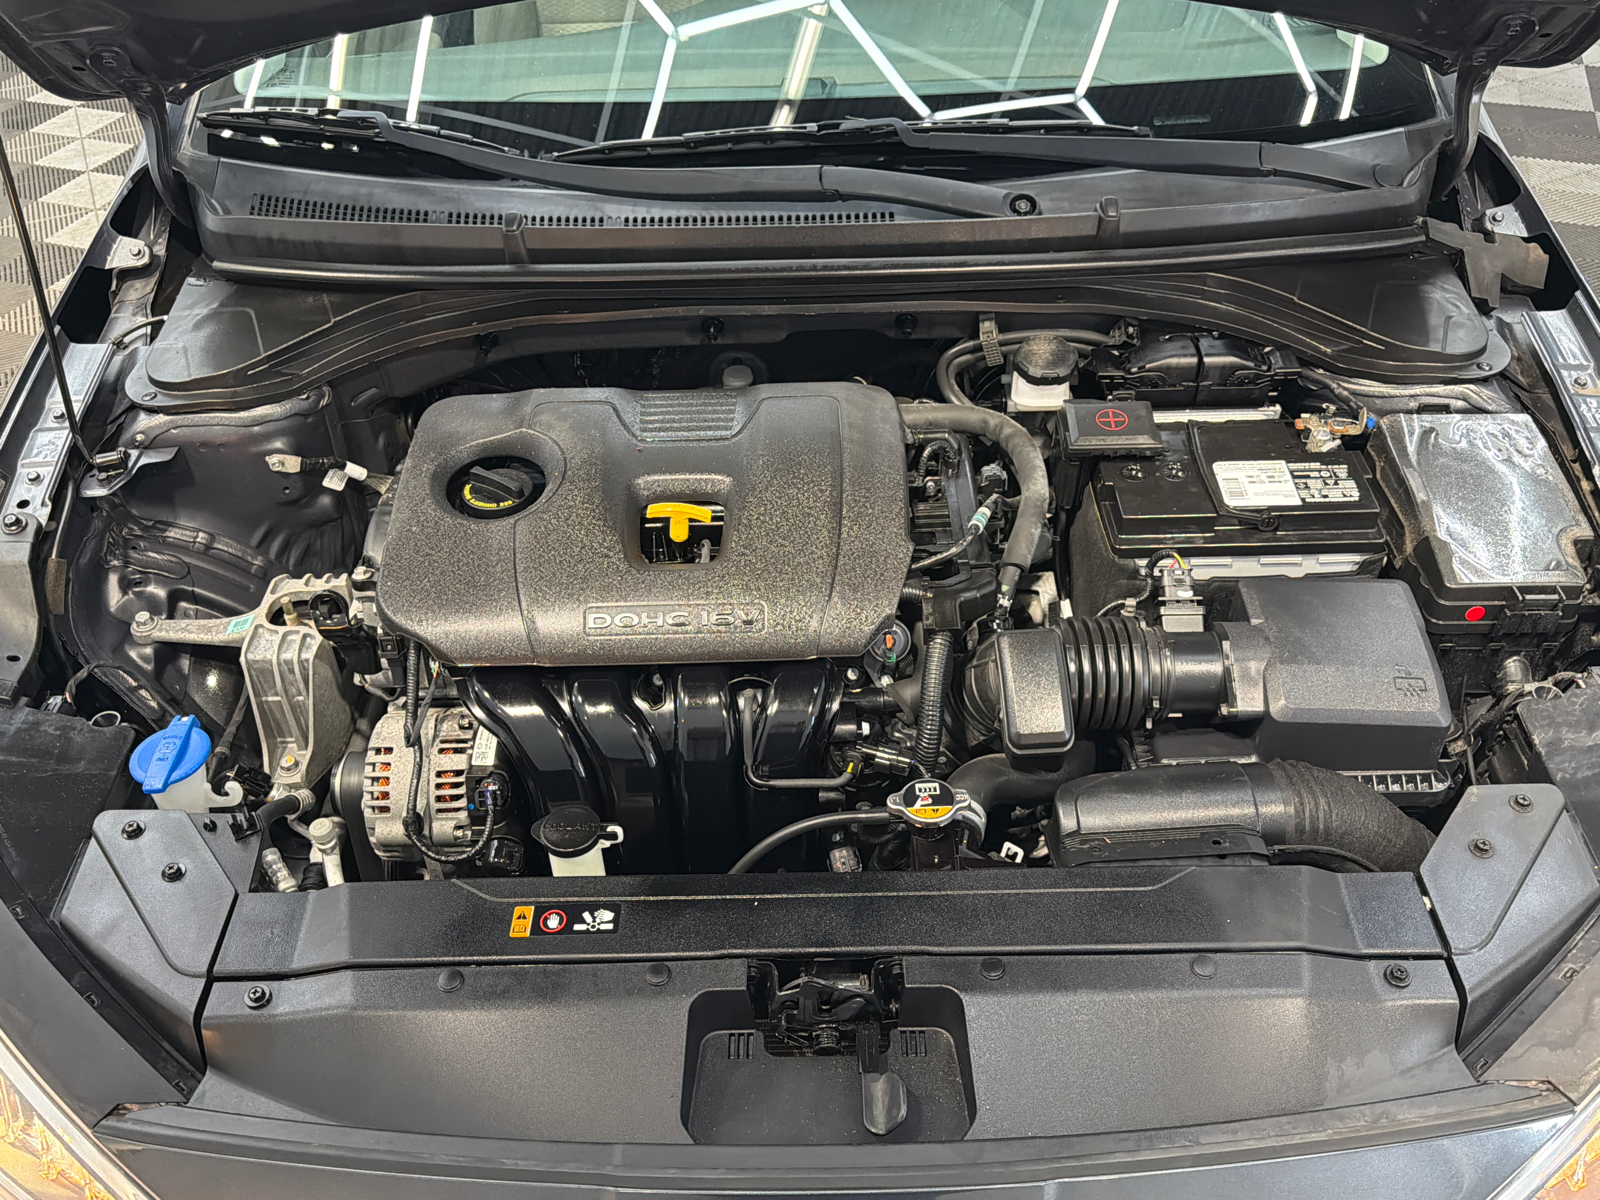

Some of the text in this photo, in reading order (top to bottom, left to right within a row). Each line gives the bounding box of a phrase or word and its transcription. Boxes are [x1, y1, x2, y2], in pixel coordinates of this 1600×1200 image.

[588, 609, 761, 629] DOHC 16V
[544, 821, 598, 831] COOLANT
